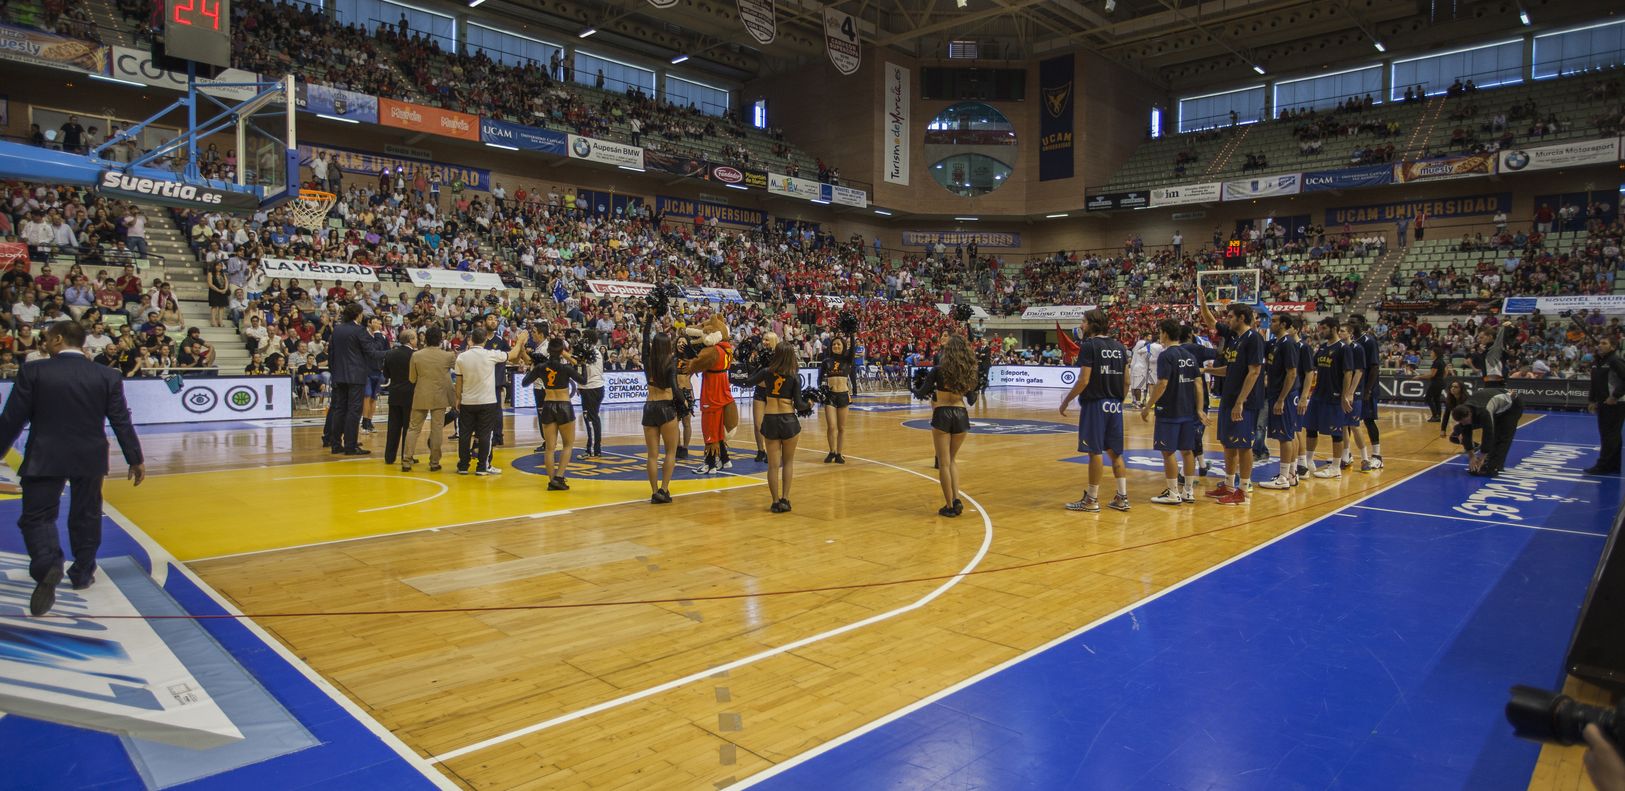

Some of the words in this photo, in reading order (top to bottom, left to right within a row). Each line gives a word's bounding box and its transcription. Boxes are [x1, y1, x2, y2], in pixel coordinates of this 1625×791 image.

[174, 0, 219, 31] 24
[841, 16, 856, 41] 4
[483, 124, 513, 139] UCAM
[1042, 132, 1073, 146] UCAM
[623, 147, 641, 157] BMW
[1535, 150, 1564, 158] Murcia
[1565, 143, 1615, 155] Motorsport
[1420, 164, 1454, 176] muesly
[103, 171, 223, 204] Suertia.es
[1306, 176, 1333, 185] UCAM
[664, 199, 695, 215] UCAM
[698, 202, 762, 224] UNIVERSIDAD
[1337, 207, 1378, 223] UCAM
[1385, 197, 1498, 219] UNIVERSIDAD
[910, 232, 940, 243] UCAM
[1226, 246, 1241, 257] 24
[263, 260, 292, 271] LA
[293, 262, 373, 276] VERDAD
[609, 377, 639, 385] CLÍNICAS
